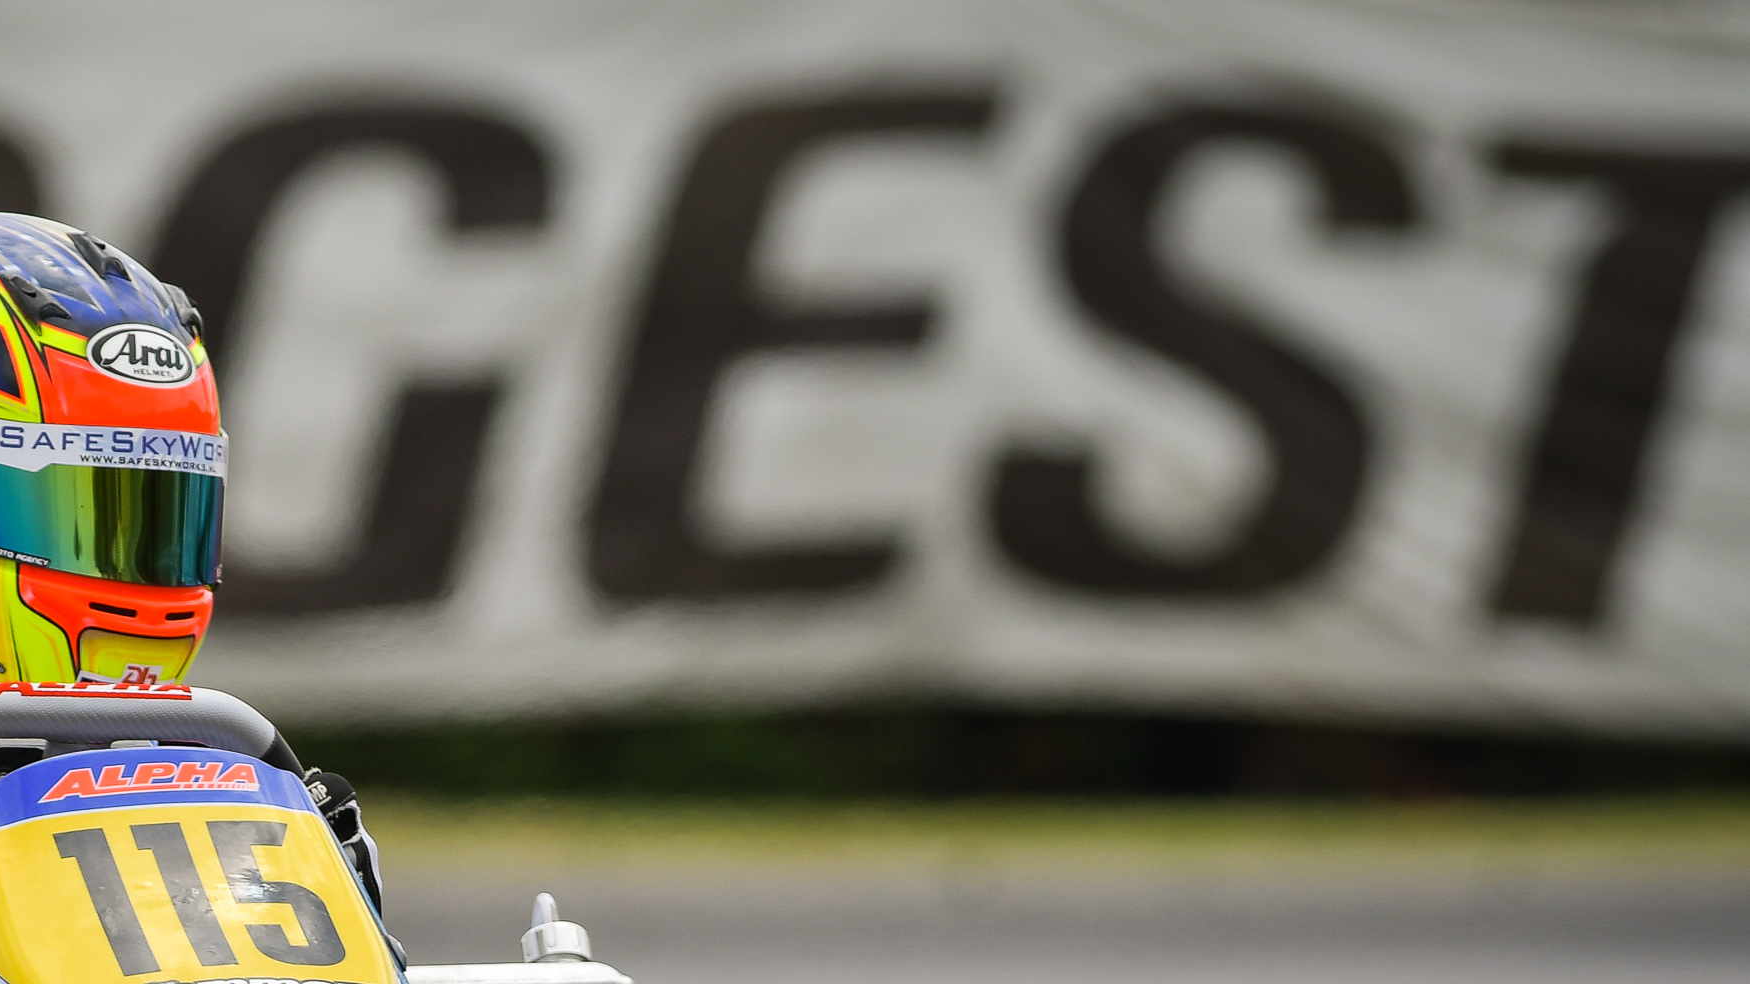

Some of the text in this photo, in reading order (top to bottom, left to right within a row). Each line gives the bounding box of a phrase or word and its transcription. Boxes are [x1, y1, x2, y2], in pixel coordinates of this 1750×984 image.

[101, 333, 184, 370] Arai
[37, 761, 260, 803] ALPHA
[53, 821, 346, 977] 115
